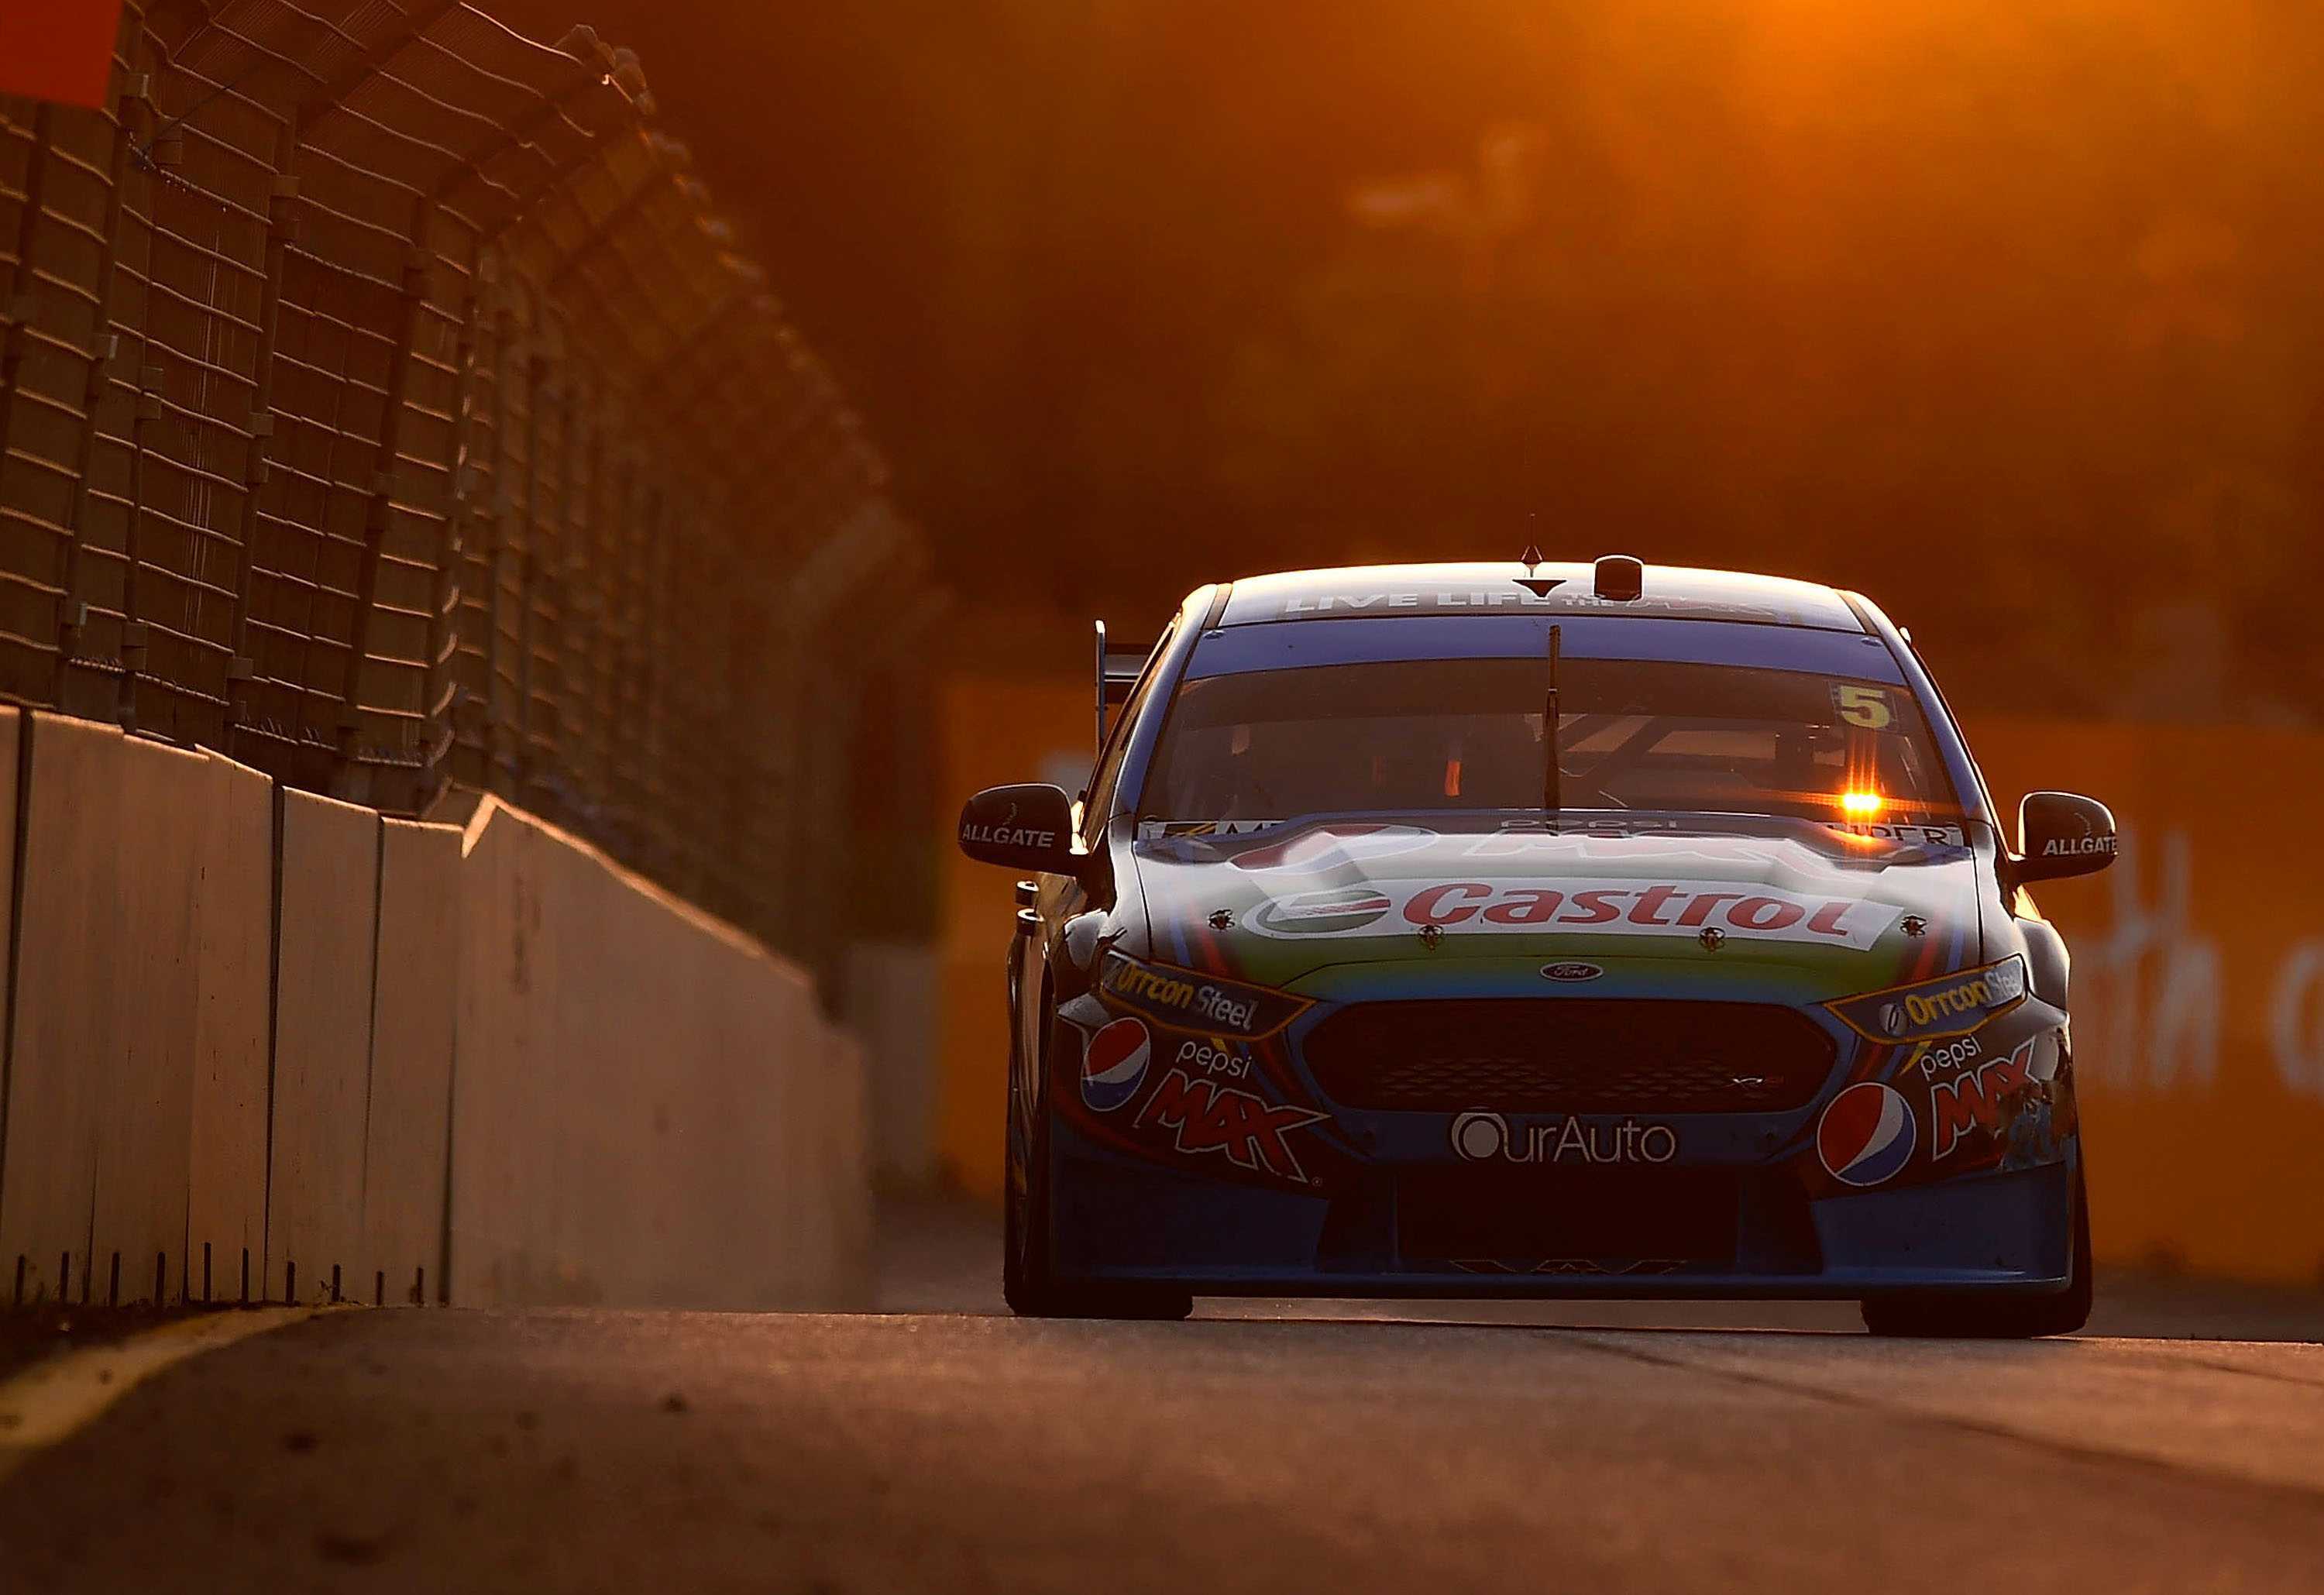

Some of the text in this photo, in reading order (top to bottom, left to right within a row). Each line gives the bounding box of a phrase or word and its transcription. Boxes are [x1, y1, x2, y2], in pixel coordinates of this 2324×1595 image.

[1285, 592, 1551, 612] LIVE LIFE
[1840, 686, 1891, 728] 5
[962, 823, 1055, 848] ALLGATE
[2042, 835, 2119, 856] ALLGATE
[1403, 882, 1848, 937] Castrol
[1553, 965, 1590, 978] Ford
[1116, 962, 1257, 1032] Orrcon Steel
[1904, 981, 1993, 1026] Orrcon
[1176, 1041, 1253, 1079] pepsi
[1920, 1033, 1983, 1082] pepsi
[1132, 1067, 1333, 1184] MAX
[1451, 1112, 1676, 1163] OurAuto
